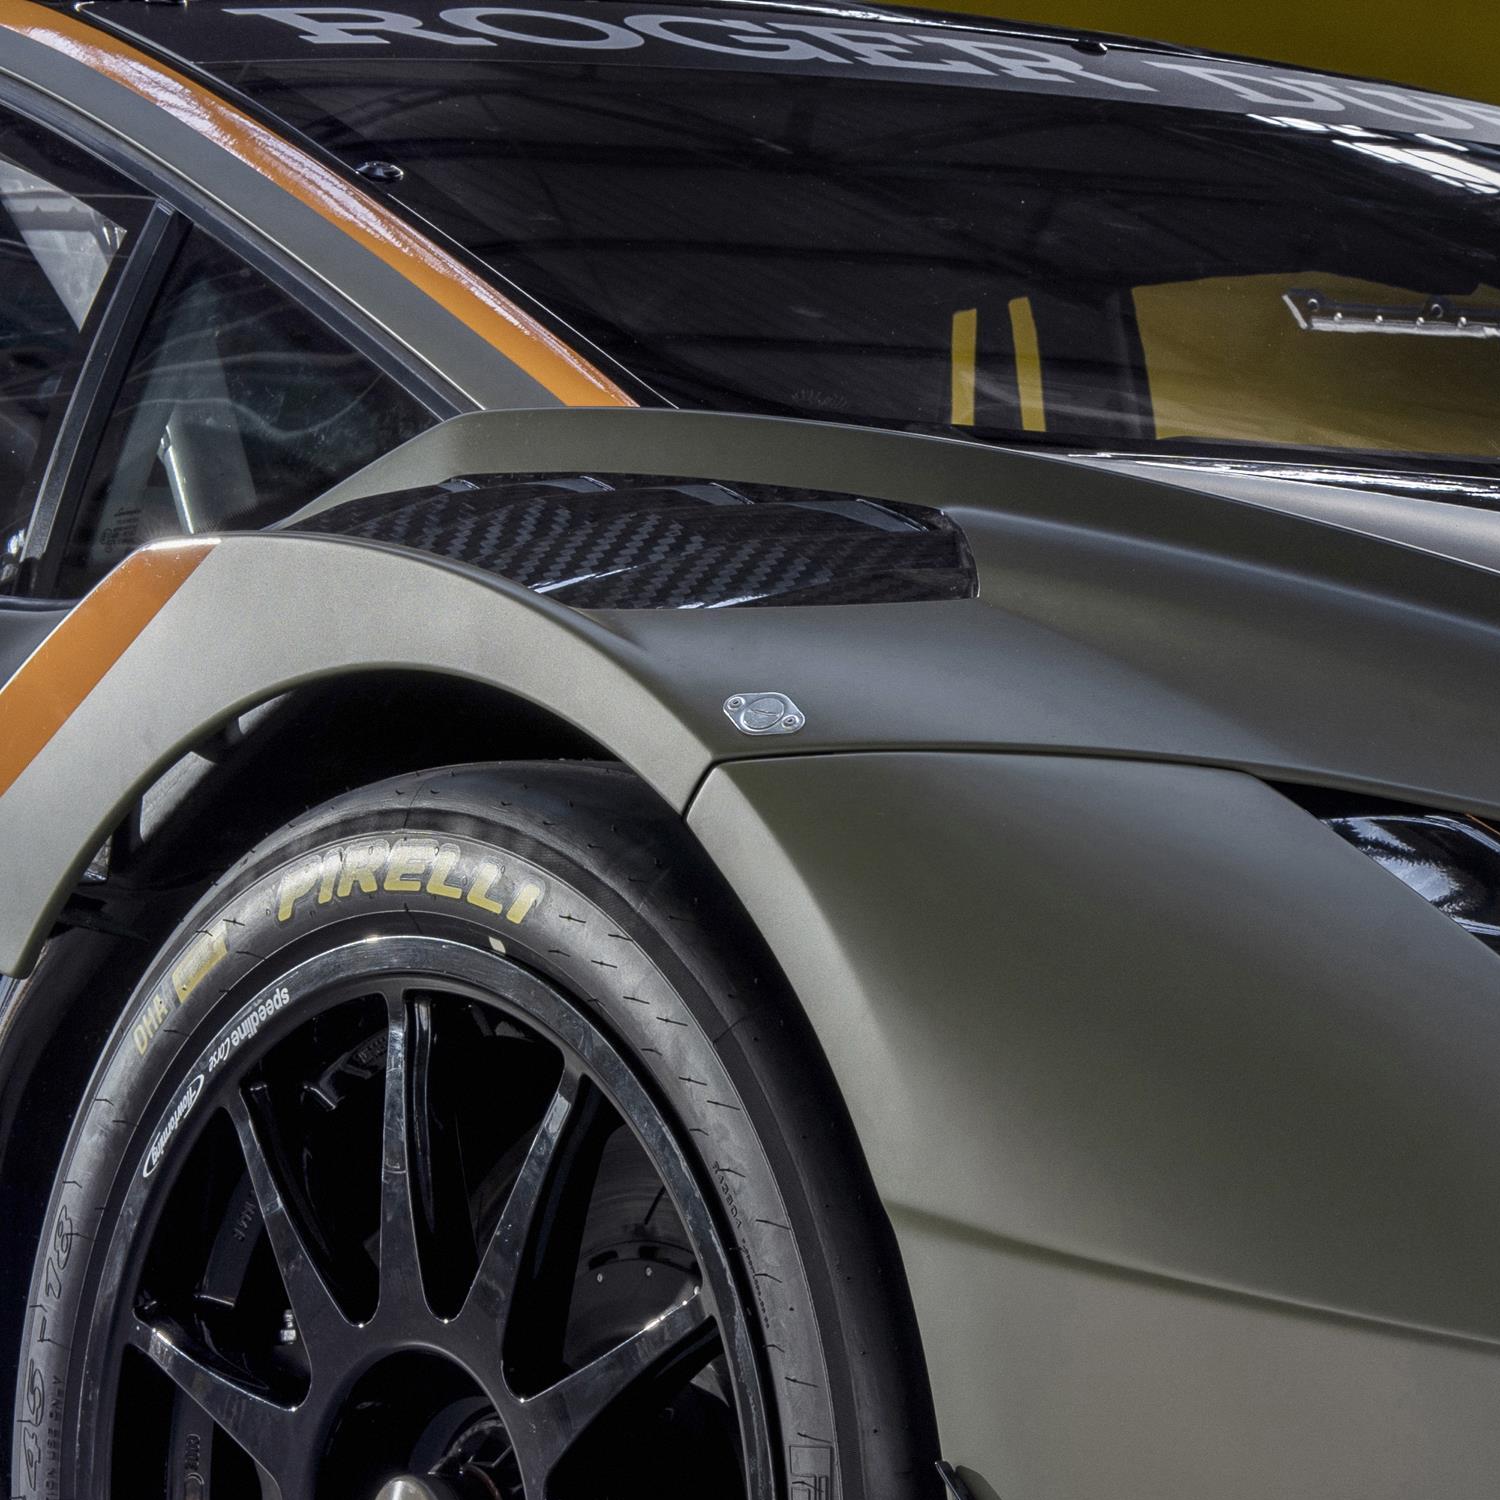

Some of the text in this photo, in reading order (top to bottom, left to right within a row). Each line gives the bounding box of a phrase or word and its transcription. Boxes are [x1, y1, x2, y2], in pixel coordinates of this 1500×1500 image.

[222, 6, 1157, 93] ROGER
[278, 838, 541, 925] PIRELLI
[231, 986, 290, 1046] speedline
